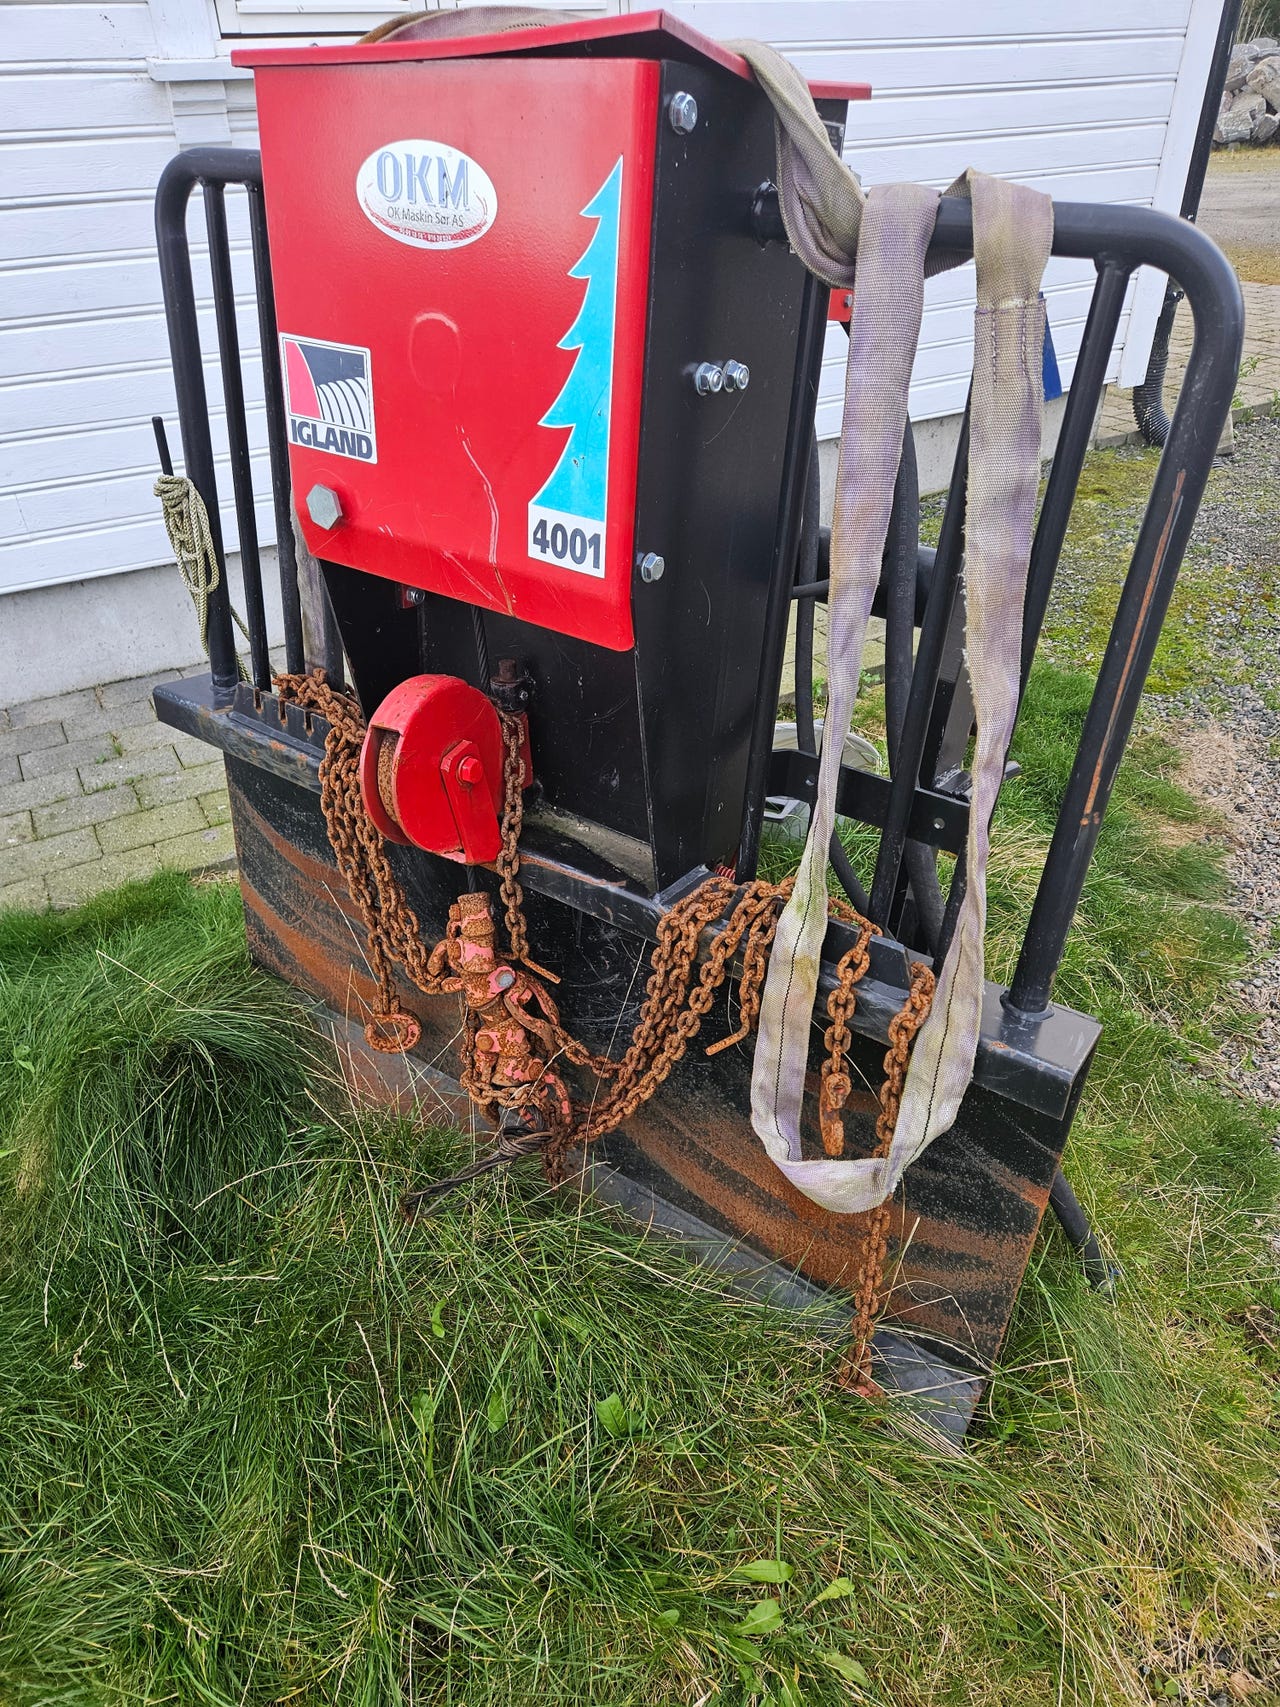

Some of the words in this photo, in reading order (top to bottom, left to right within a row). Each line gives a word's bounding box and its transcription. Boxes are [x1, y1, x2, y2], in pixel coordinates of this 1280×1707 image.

[376, 151, 470, 211] OKM
[387, 206, 400, 219] OK
[402, 208, 433, 224] Maskin
[451, 214, 464, 228] AS
[290, 418, 373, 460] IGLAND
[532, 518, 602, 570] 4001
